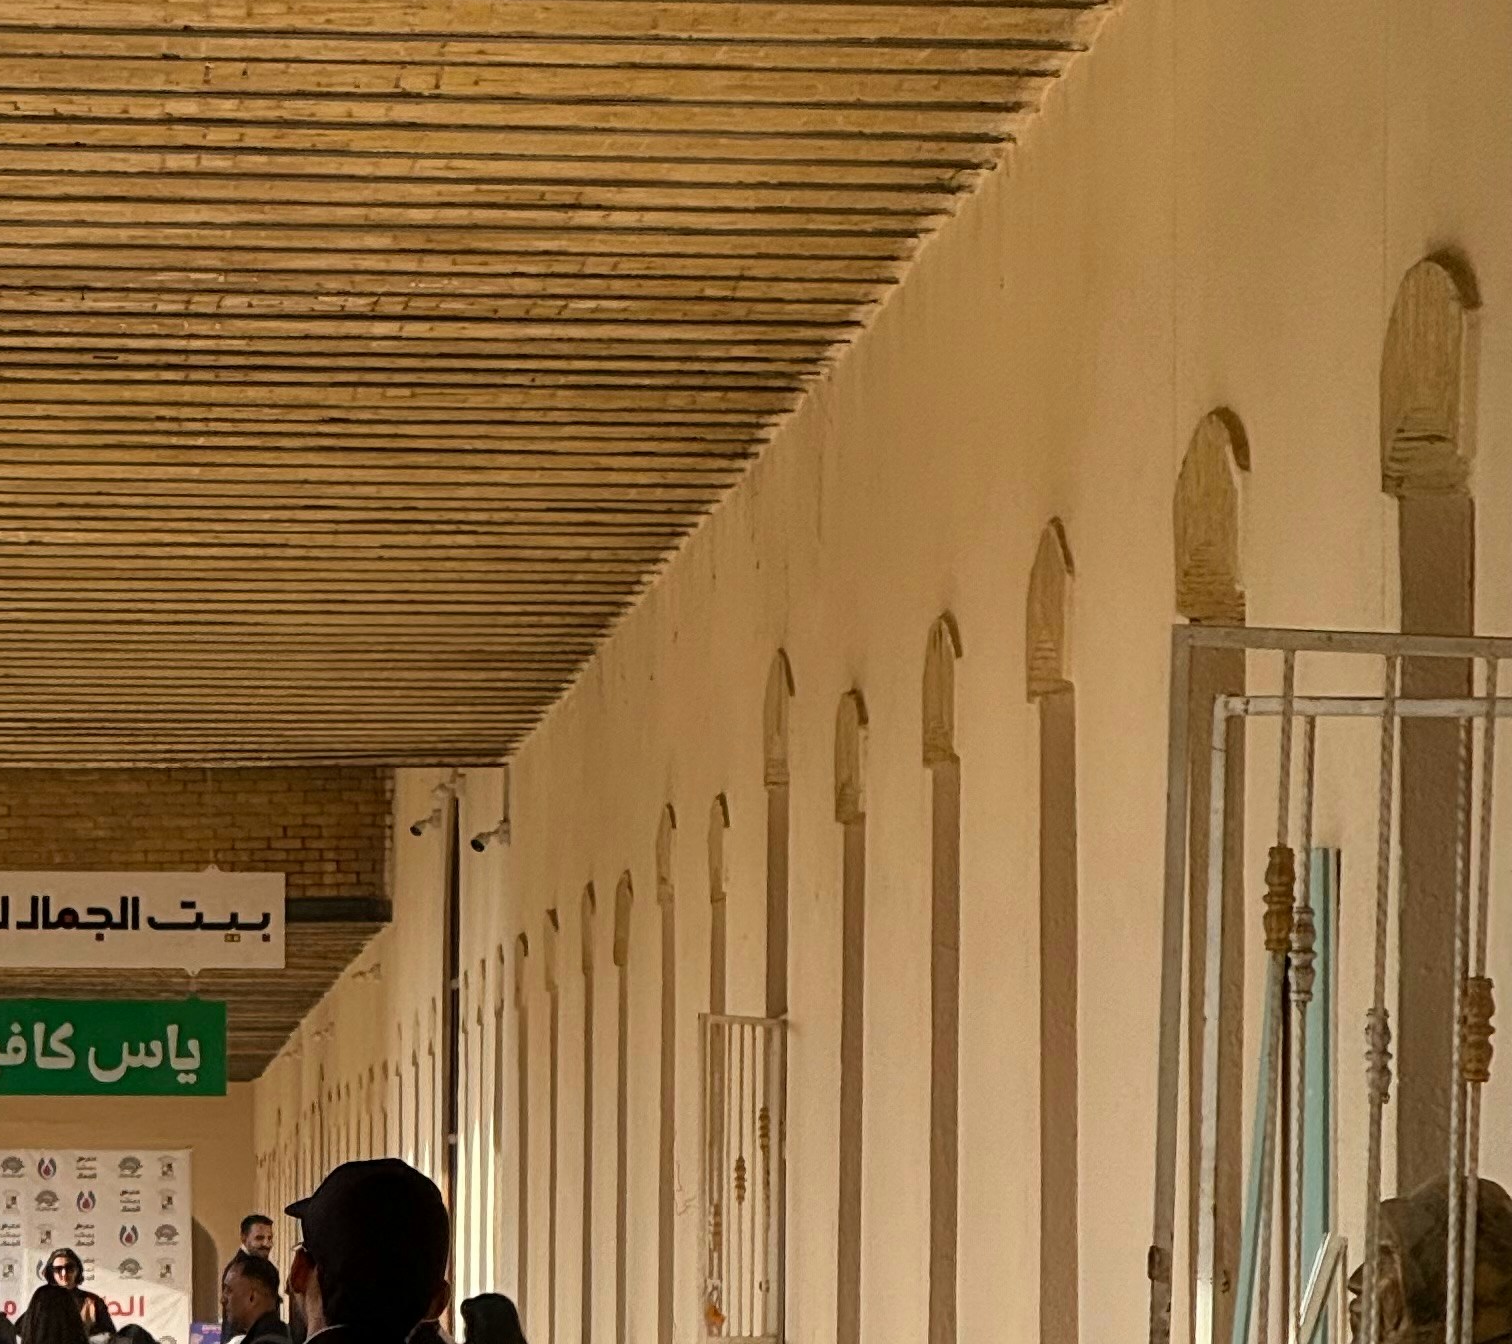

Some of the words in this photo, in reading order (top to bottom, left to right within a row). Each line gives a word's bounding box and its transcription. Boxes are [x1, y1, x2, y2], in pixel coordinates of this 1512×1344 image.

[15, 894, 141, 942] الجمال
[146, 899, 272, 943] بيت
[88, 1024, 202, 1084] ياس
